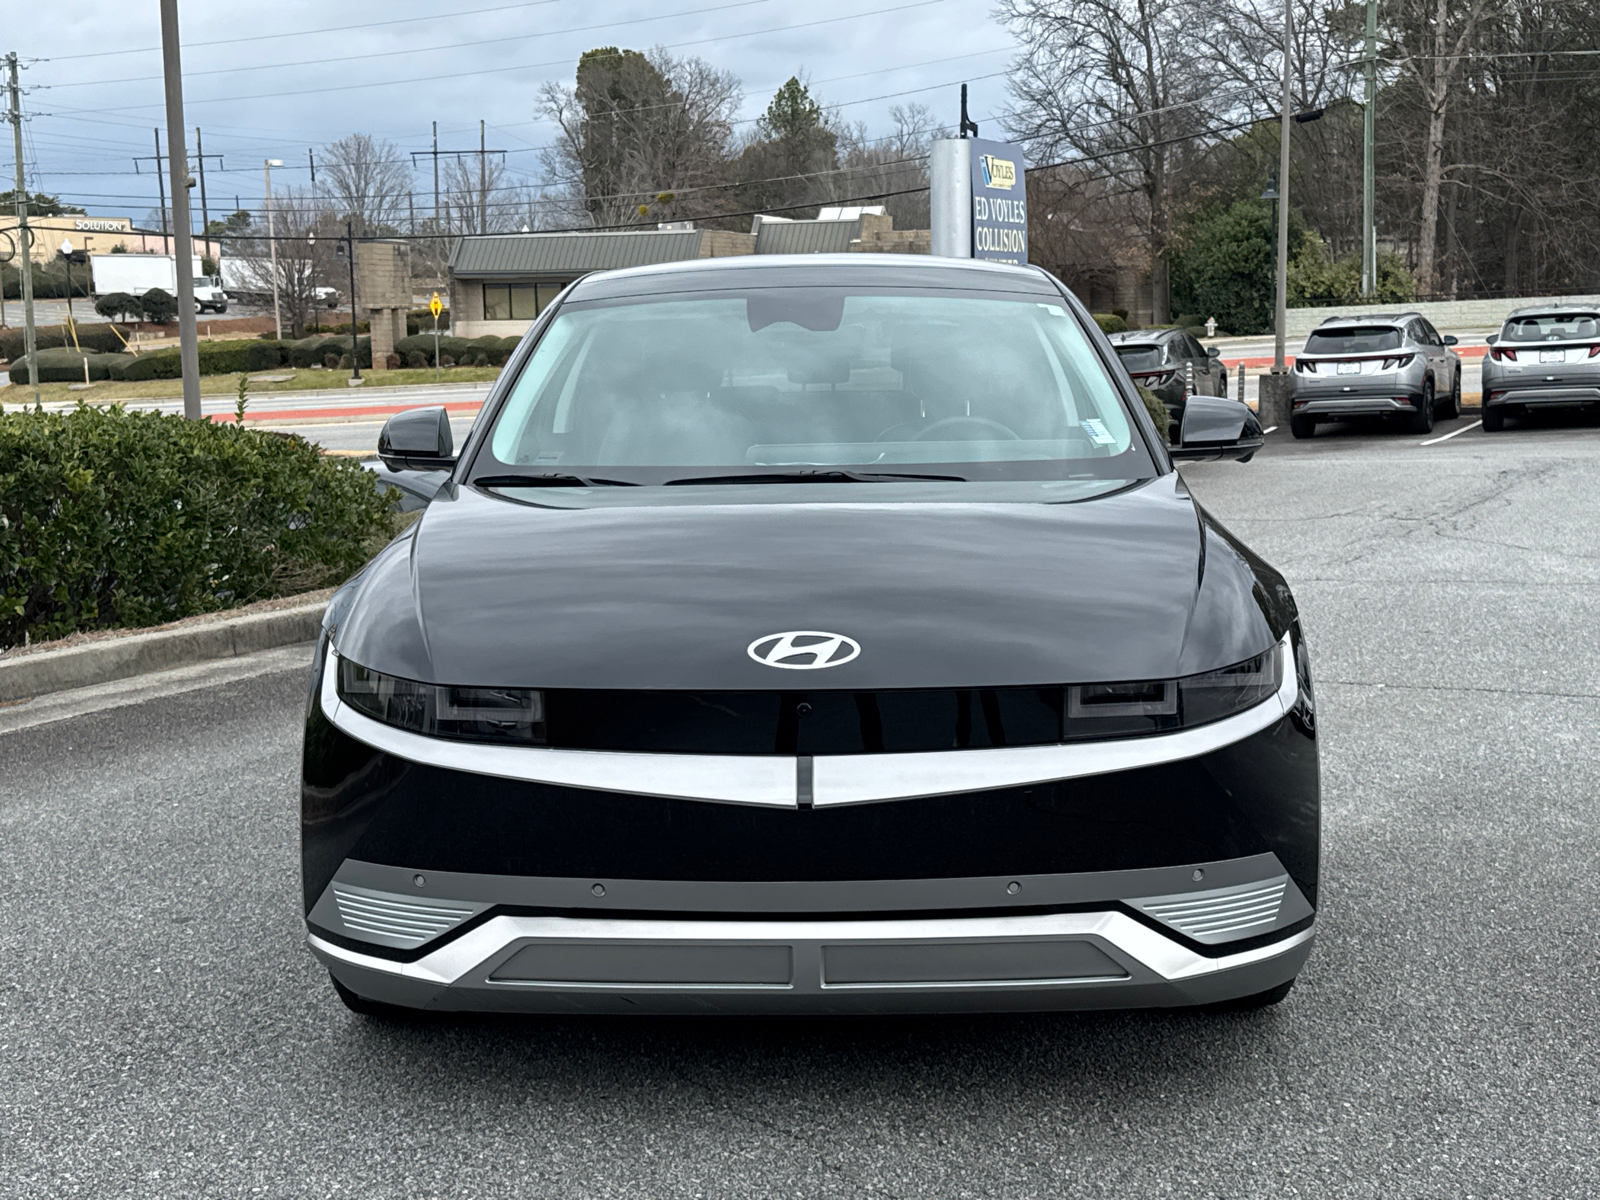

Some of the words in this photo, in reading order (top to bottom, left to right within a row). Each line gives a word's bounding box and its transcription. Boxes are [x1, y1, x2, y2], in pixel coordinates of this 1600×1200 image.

[984, 155, 1014, 183] VOYLES
[975, 197, 989, 220] ED
[990, 198, 1025, 224] VOYLES
[976, 227, 1025, 253] COLLISION
